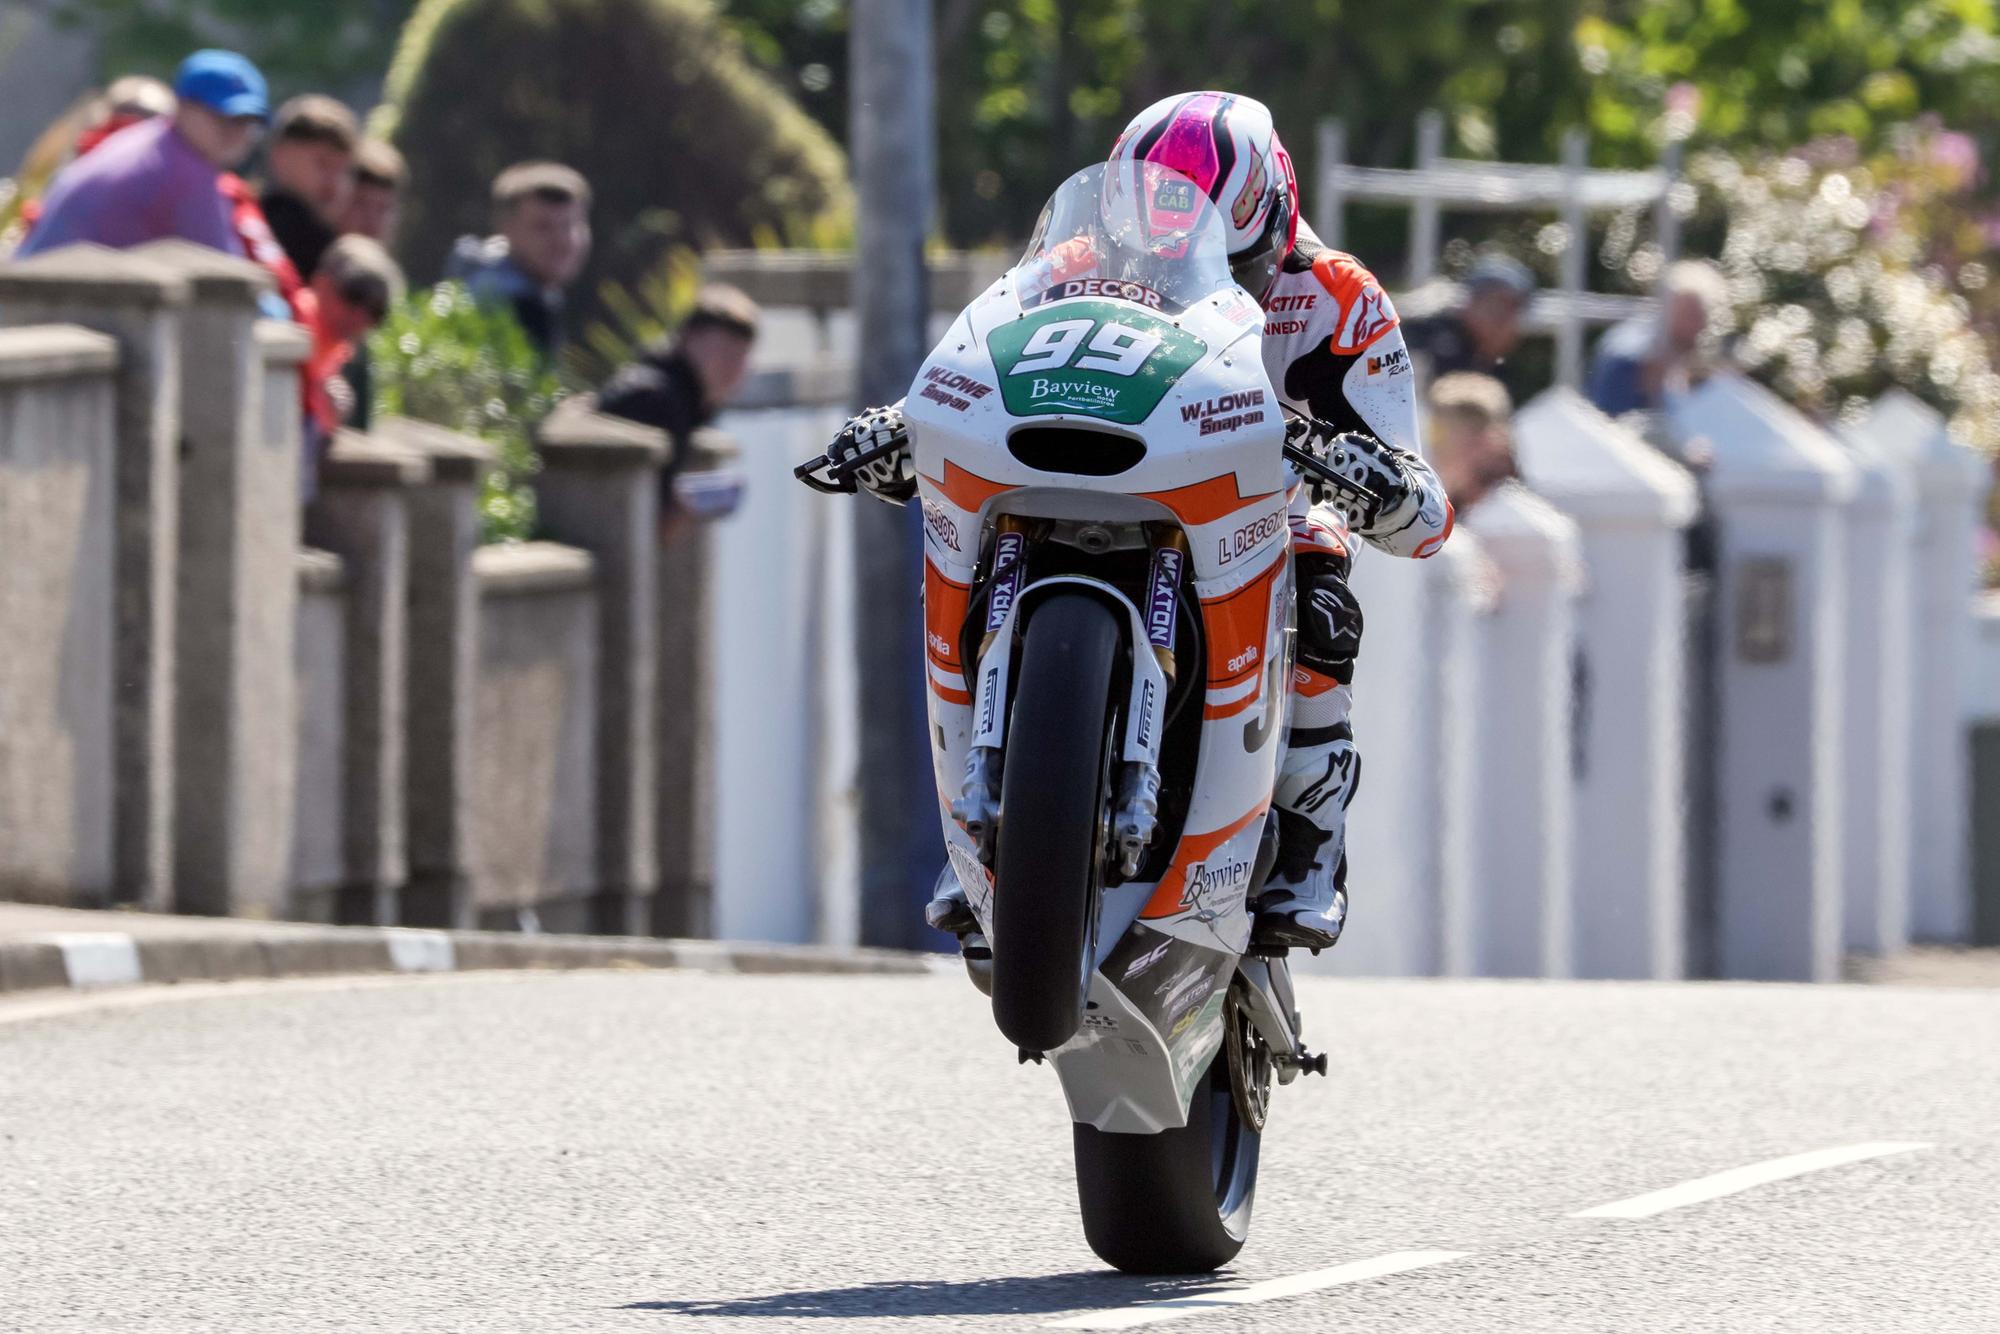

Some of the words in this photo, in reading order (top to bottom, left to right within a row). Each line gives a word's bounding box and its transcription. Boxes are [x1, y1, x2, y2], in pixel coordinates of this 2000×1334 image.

[1159, 194, 1189, 208] CAB
[1040, 289, 1054, 305] L
[1064, 280, 1162, 309] DECOR
[1007, 319, 1162, 377] 99
[924, 366, 994, 399] W.LOWE
[1030, 378, 1120, 399] Bayview
[1180, 389, 1264, 423] W.LOWE
[1200, 410, 1264, 437] Snap-on
[1219, 538, 1231, 565] L
[1234, 505, 1287, 558] DECOR
[991, 538, 1018, 626] MAXON
[1150, 552, 1179, 641] MAXTON
[1227, 645, 1258, 672] aprilia
[981, 667, 998, 734] PIRELLI
[1137, 679, 1154, 748] PIRELLI
